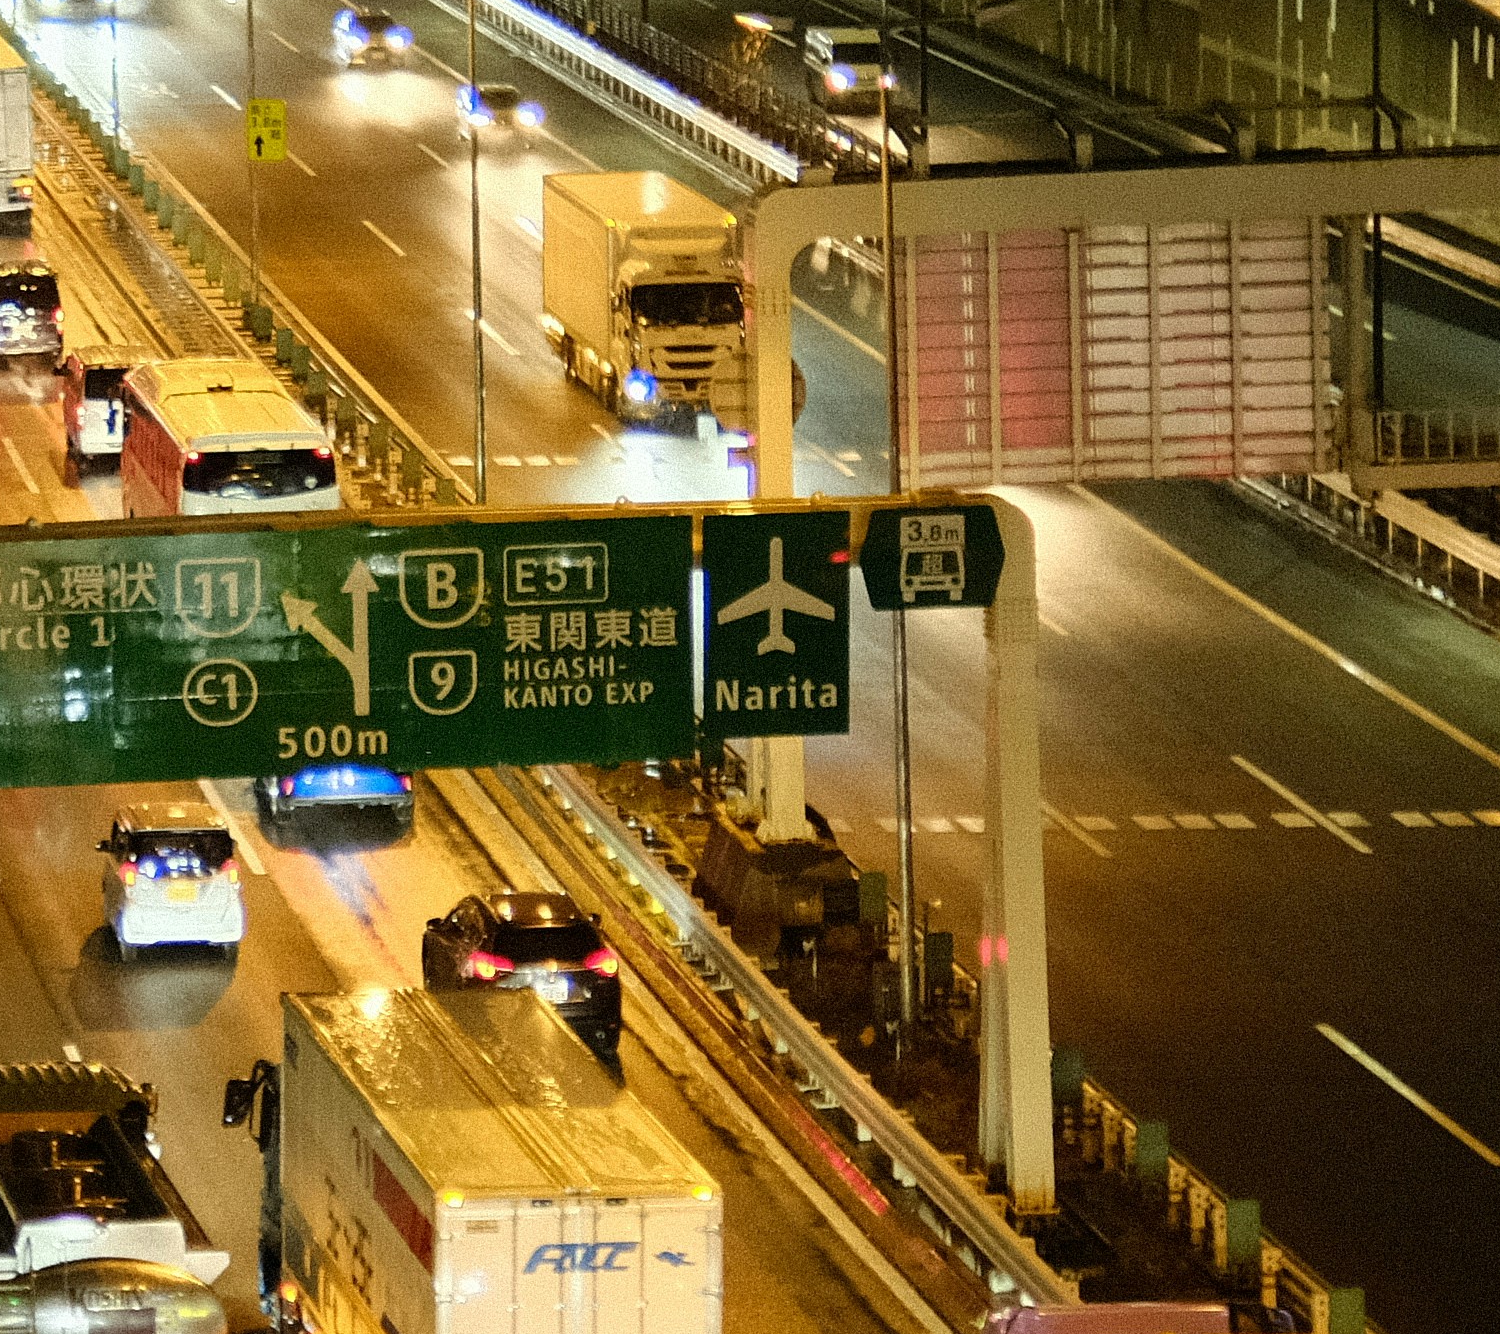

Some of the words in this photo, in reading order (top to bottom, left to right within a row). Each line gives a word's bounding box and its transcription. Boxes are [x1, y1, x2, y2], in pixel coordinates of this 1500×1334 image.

[907, 520, 960, 542] 3.8m
[427, 563, 459, 611] B
[514, 554, 597, 594] E51
[193, 570, 240, 620] 11
[91, 616, 111, 648] 1
[503, 608, 678, 653] 東関東道
[430, 662, 455, 701] 9
[503, 656, 627, 682] HIGASHI-
[196, 673, 238, 711] C1
[605, 682, 654, 705] EXP
[714, 677, 839, 713] Narita
[277, 724, 389, 760] 500m
